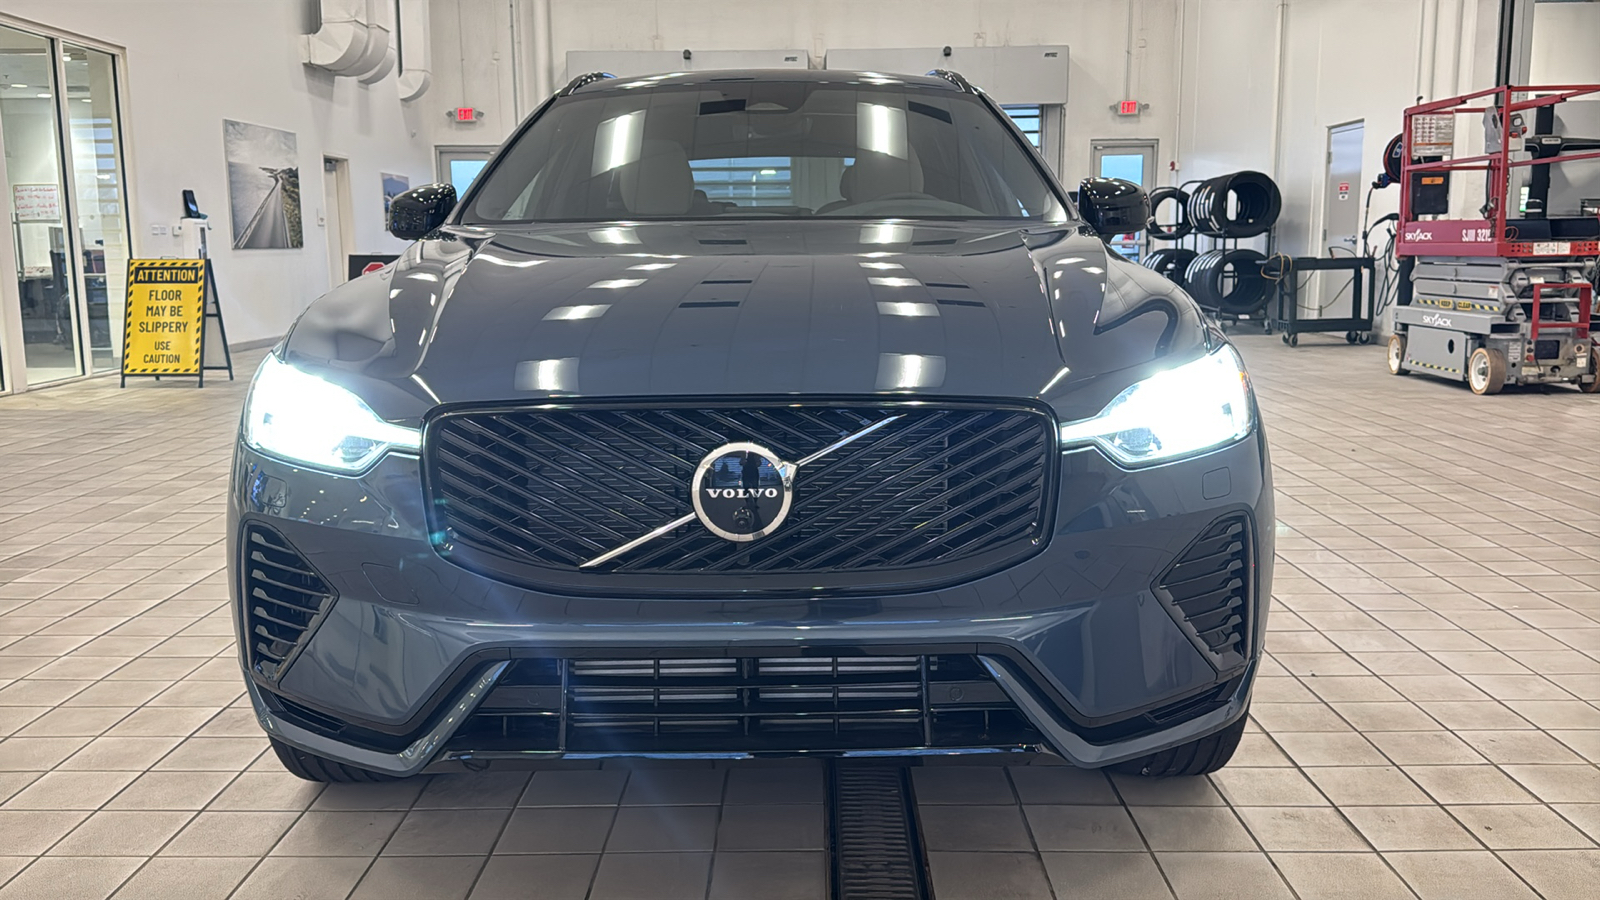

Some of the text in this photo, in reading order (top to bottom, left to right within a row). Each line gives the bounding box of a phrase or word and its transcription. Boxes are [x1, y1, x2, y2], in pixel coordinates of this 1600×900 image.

[1121, 100, 1137, 114] EXIT
[457, 107, 473, 120] EXIT
[1404, 228, 1433, 242] SKYJACK
[136, 269, 195, 282] ATTENTION
[148, 289, 182, 301] FLOOR
[145, 305, 183, 317] MAY BE
[1422, 313, 1452, 327] SKYJACK
[138, 321, 189, 333] SLIPPERY
[154, 340, 171, 351] USE
[143, 354, 181, 364] CAUTION
[705, 487, 778, 499] VOLVO
